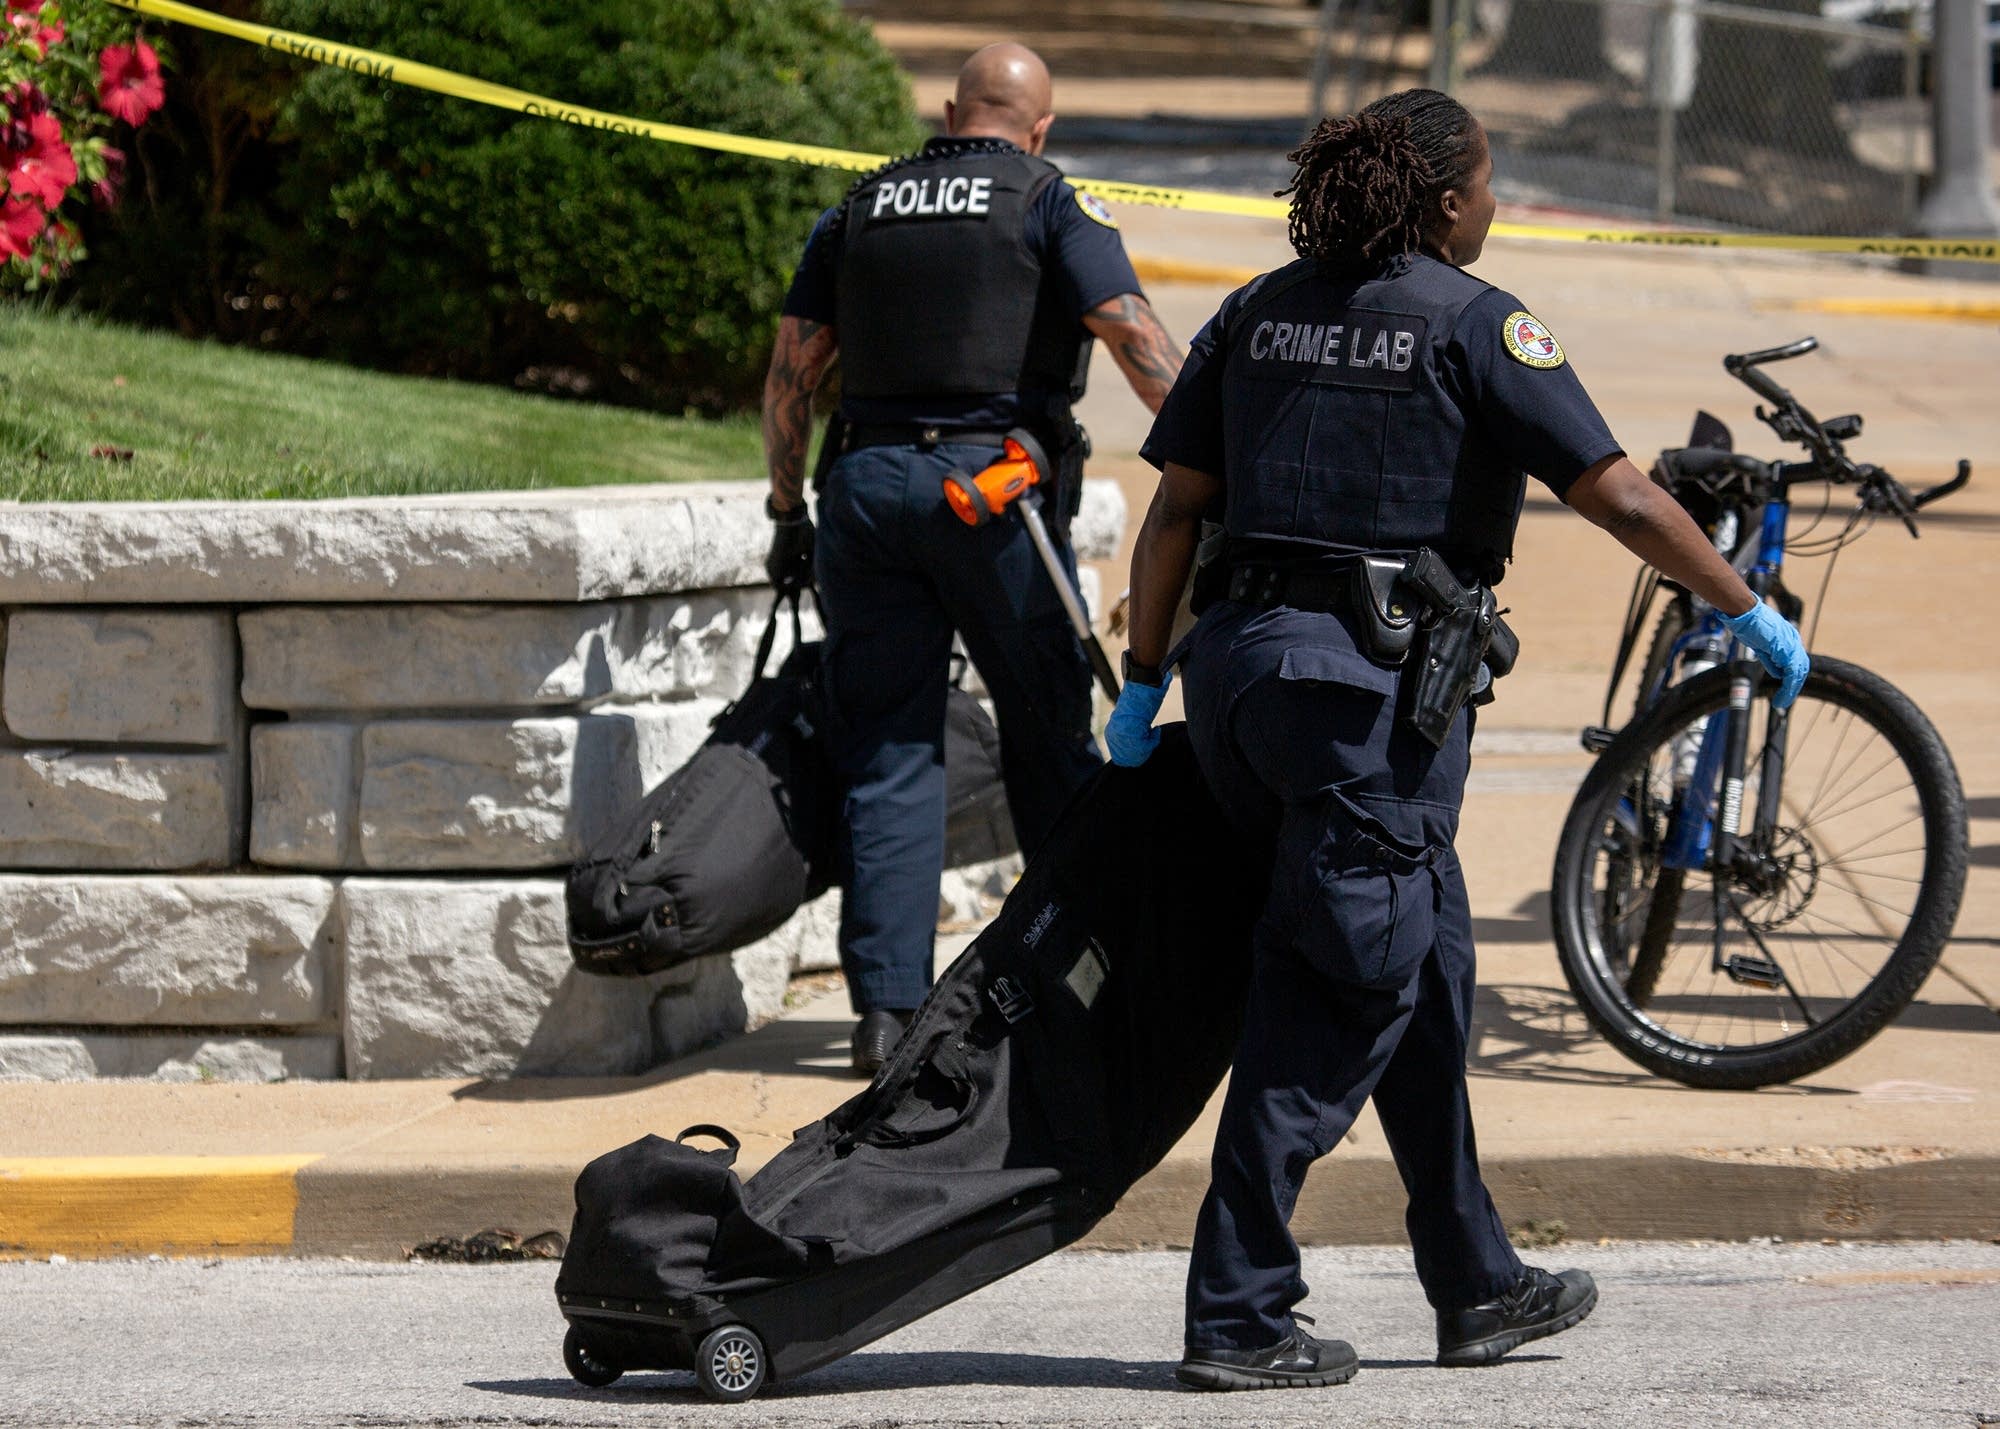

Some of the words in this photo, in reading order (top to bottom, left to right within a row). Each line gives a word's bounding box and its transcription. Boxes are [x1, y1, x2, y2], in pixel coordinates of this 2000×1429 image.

[872, 176, 992, 217] POLICE
[1250, 320, 1344, 366] CRIME
[1349, 327, 1415, 372] LAB
[1629, 1029, 1713, 1065] SERFAS
